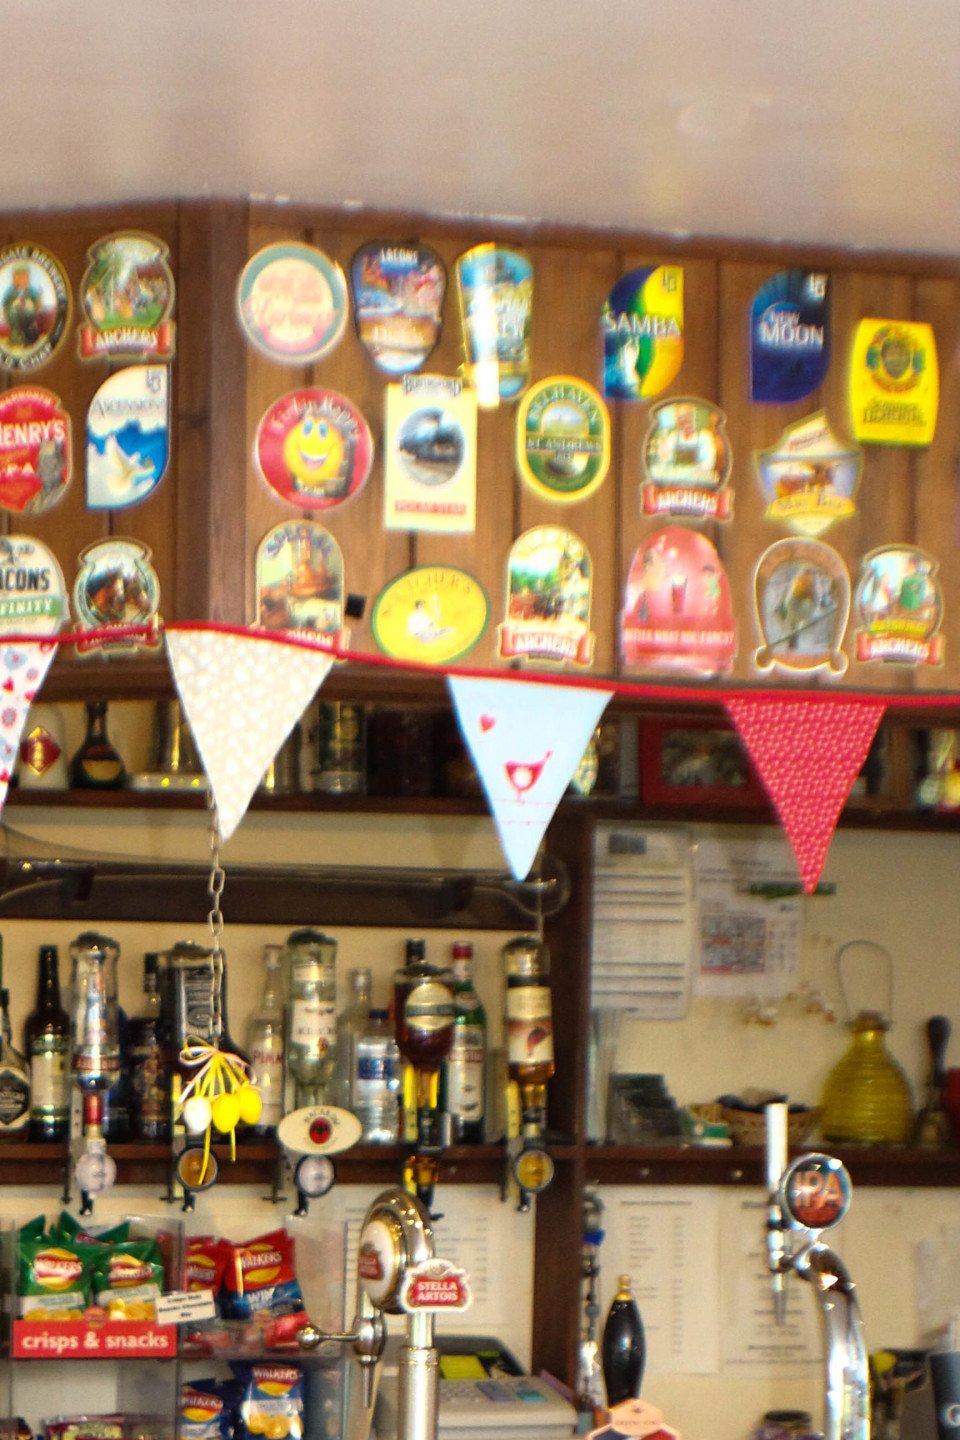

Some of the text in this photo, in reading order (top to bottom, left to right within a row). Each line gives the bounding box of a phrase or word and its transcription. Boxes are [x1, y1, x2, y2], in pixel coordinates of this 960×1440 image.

[603, 311, 681, 338] SAMBA
[762, 322, 824, 346] MOON
[794, 1170, 845, 1208] IPA
[417, 1291, 458, 1301] ARTOIS
[418, 1281, 458, 1291] STELLA
[21, 1331, 169, 1354] crisps & snacks
